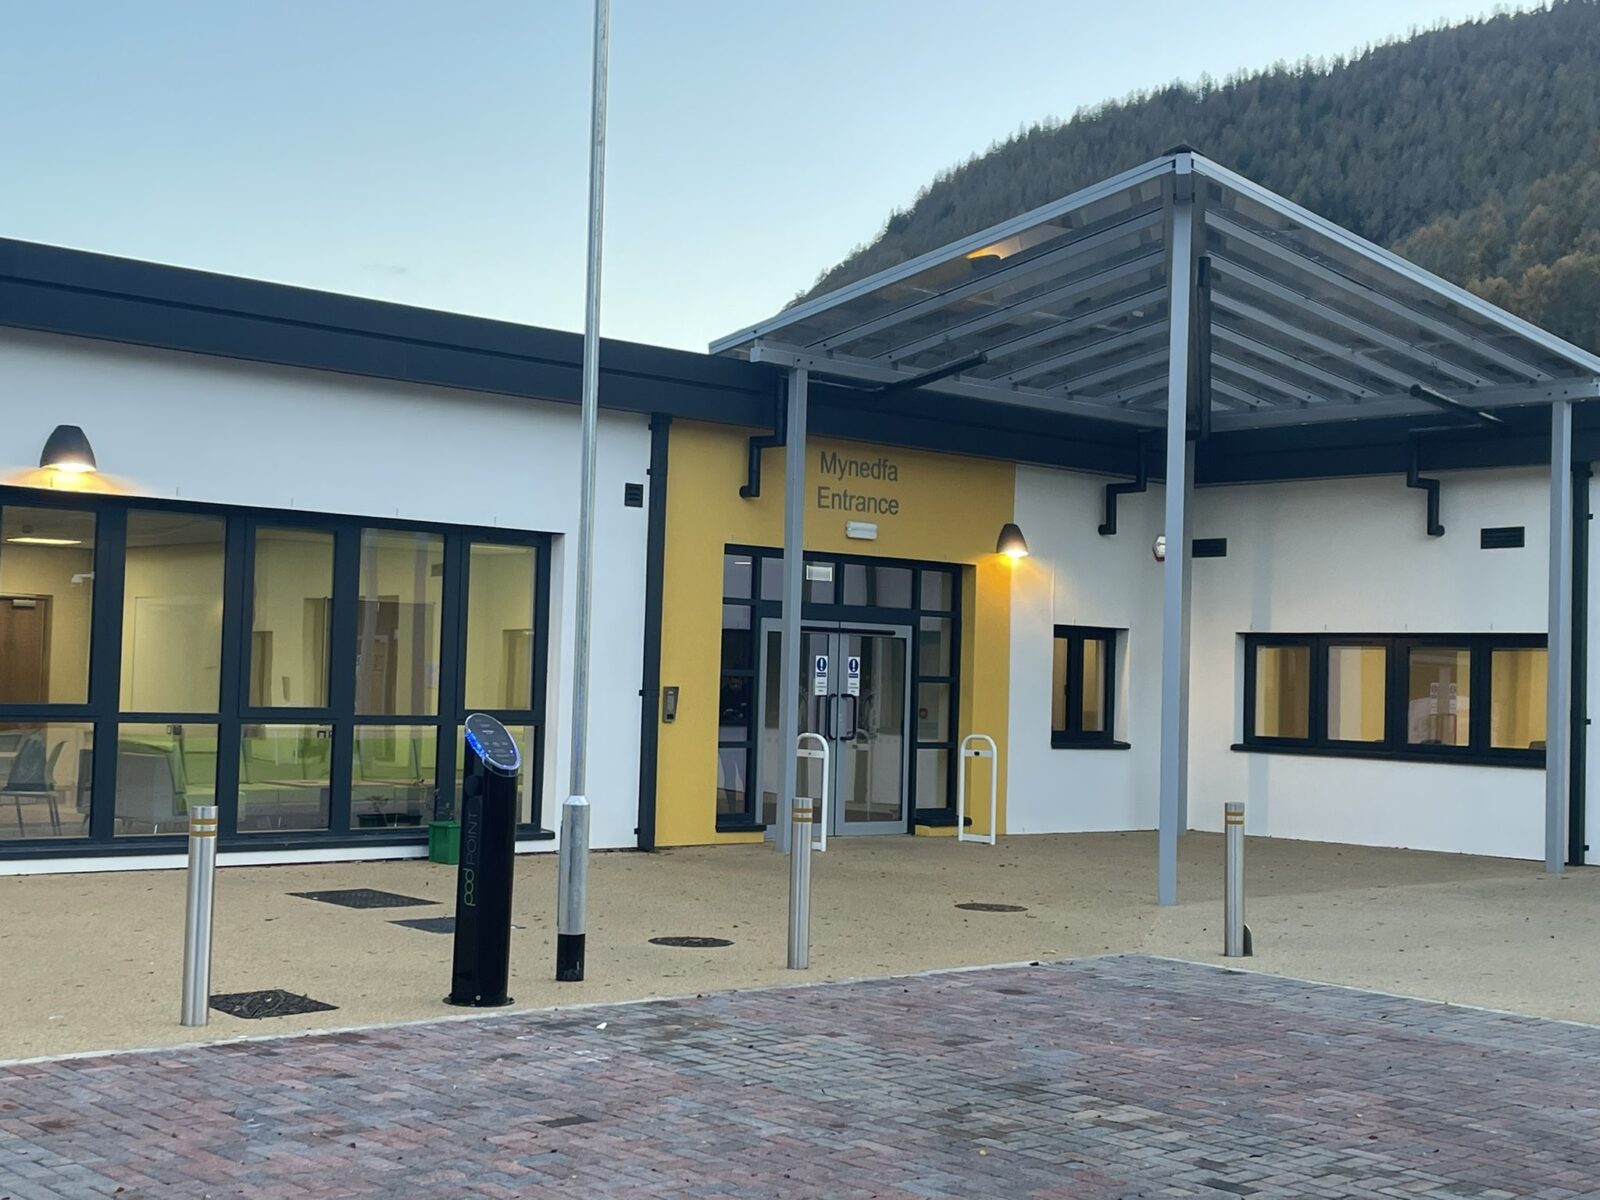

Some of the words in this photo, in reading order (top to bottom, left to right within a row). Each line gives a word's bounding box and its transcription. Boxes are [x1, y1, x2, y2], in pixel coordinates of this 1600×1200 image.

[820, 450, 898, 482] Mynedfa
[817, 486, 899, 515] Entrance
[465, 813, 480, 865] POINT
[463, 868, 476, 907] pod
